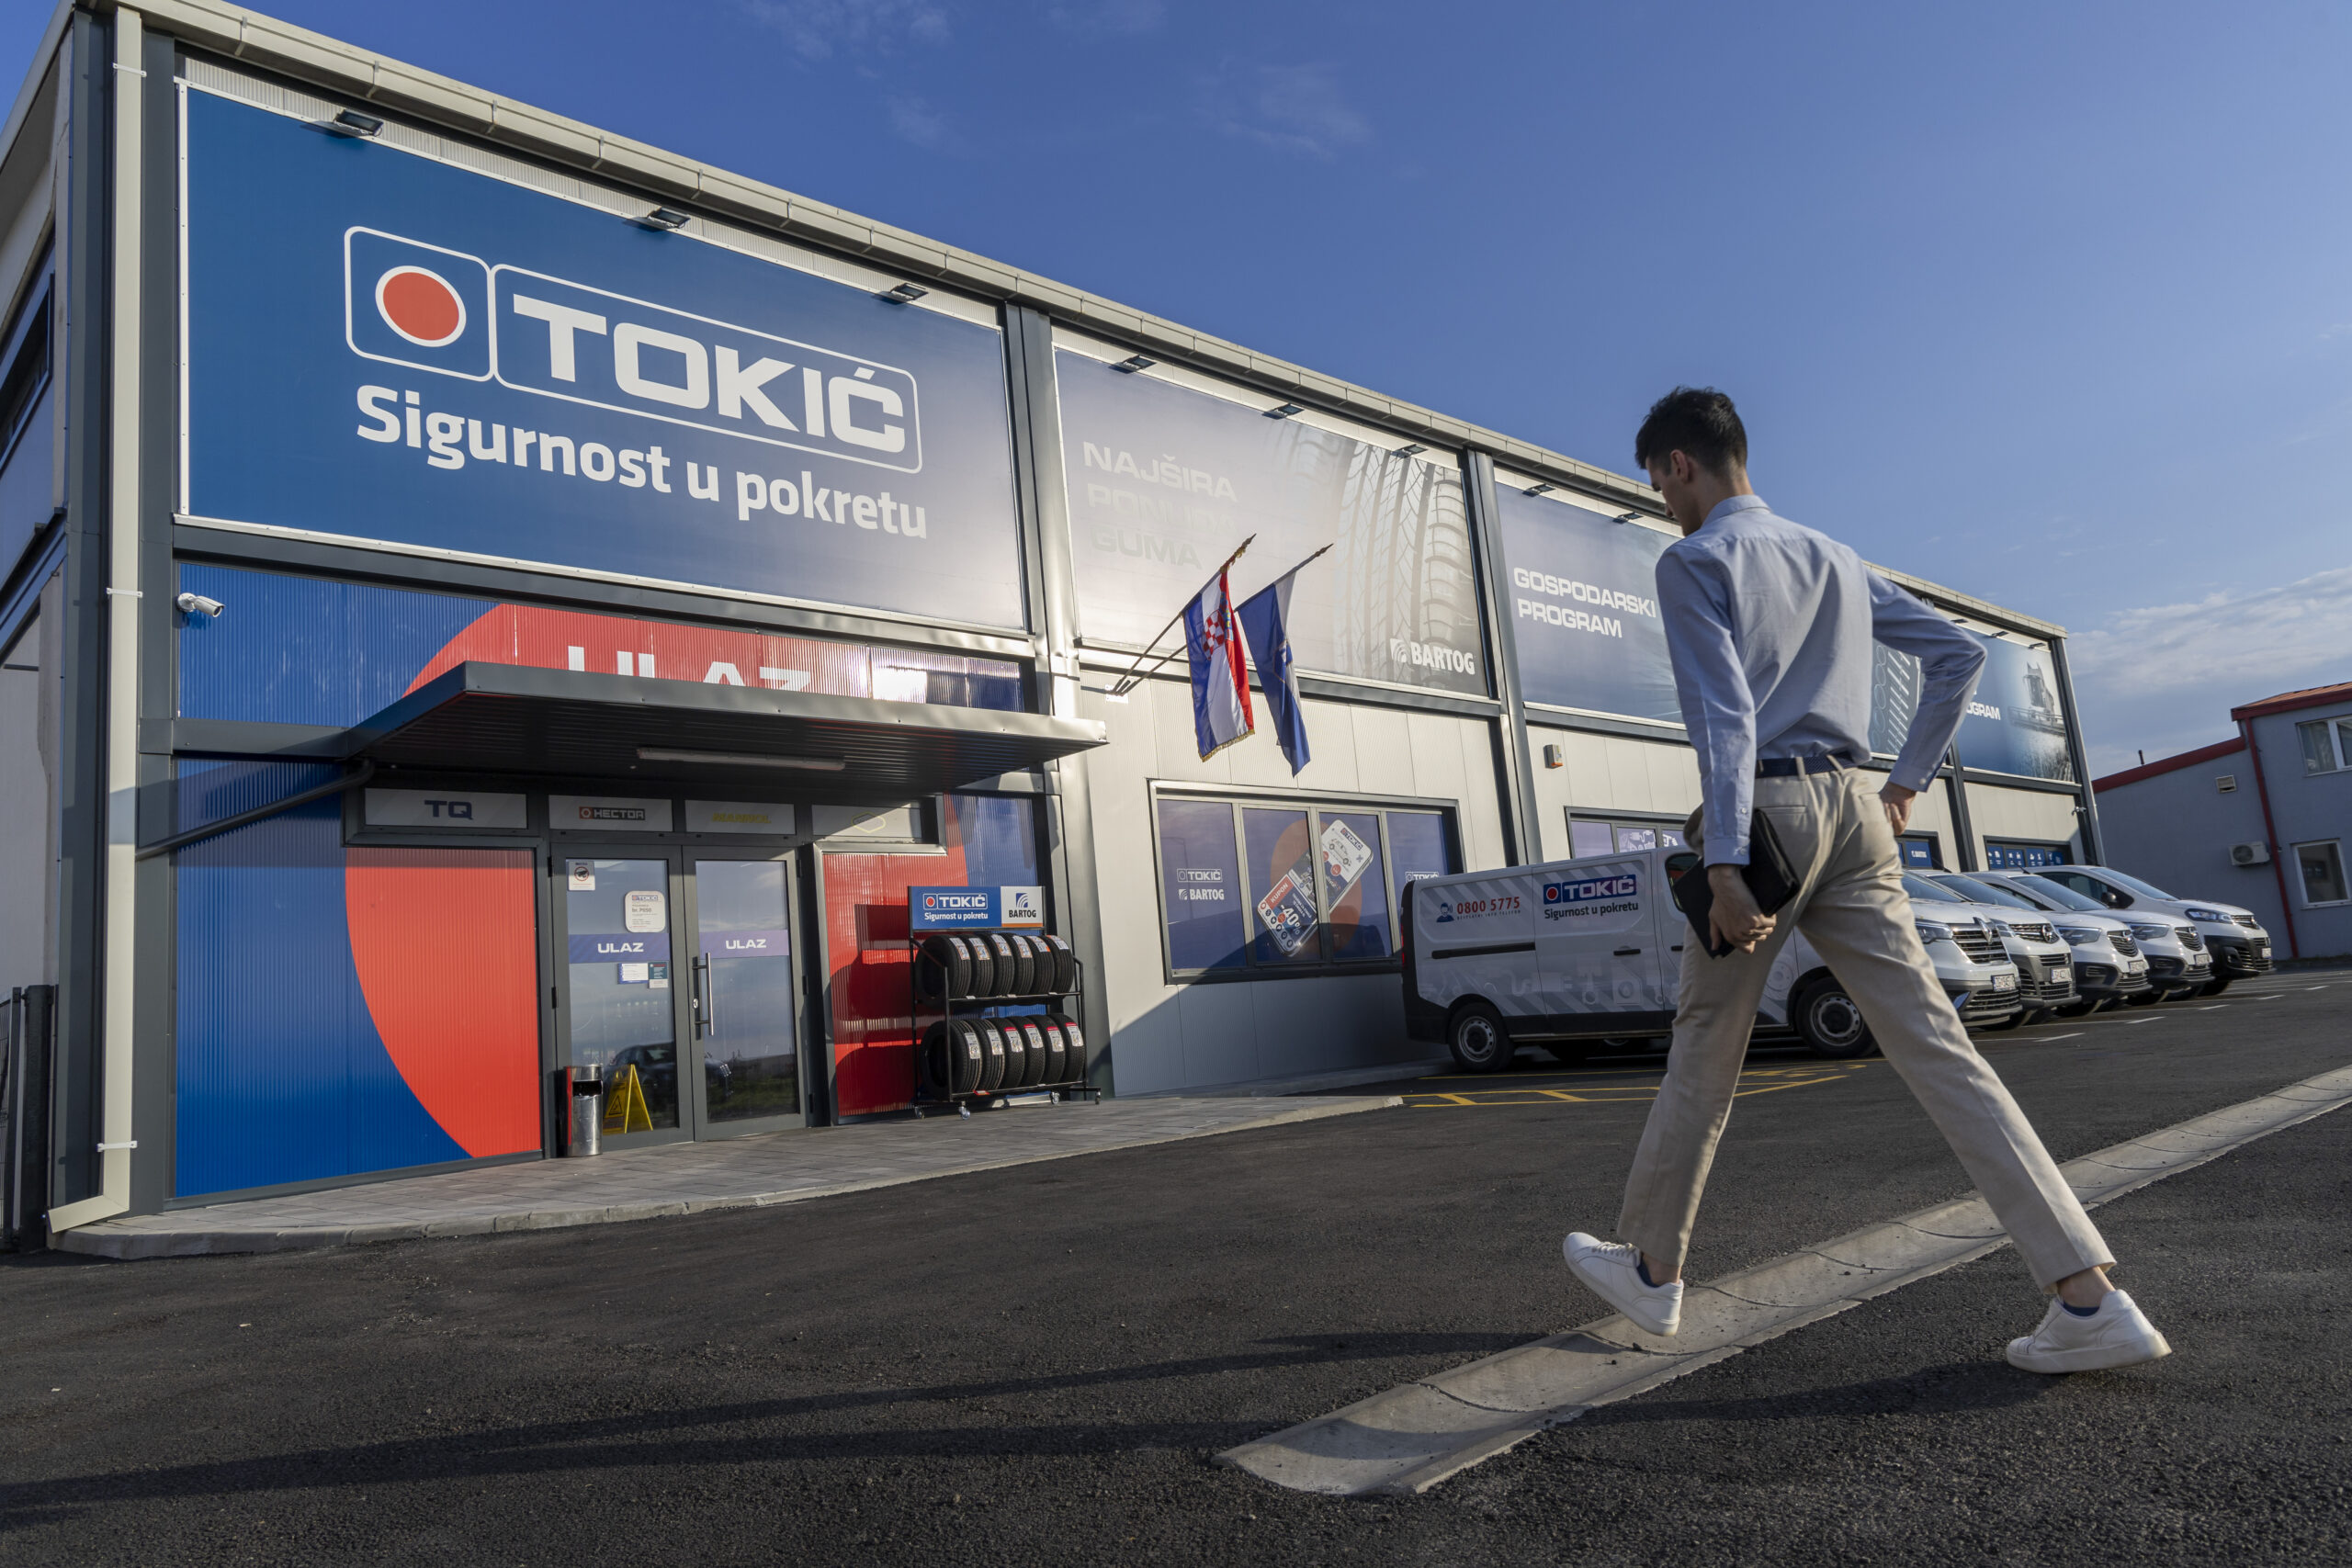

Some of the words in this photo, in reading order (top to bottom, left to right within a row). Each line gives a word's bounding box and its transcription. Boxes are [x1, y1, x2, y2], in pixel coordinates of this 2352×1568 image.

[514, 293, 905, 453] TOKIĆ
[356, 385, 672, 492] Sigurnost
[687, 461, 720, 502] u
[737, 470, 927, 539] pokretu
[1083, 441, 1238, 502] NAJŠIRA
[1087, 483, 1238, 536] PONUDA
[1090, 525, 1204, 570] GUMA
[1513, 567, 1657, 618] GOSPODARSKI
[1517, 598, 1623, 637] PROGRAM
[1410, 641, 1476, 675] BARTOG
[424, 799, 474, 820] TQ
[594, 808, 644, 819] HECTOR
[1188, 869, 1221, 880] TOKIĆ
[1190, 888, 1225, 900] BARTOG
[1271, 882, 1289, 904] KUPON
[1564, 875, 1634, 900] TOKIĆ
[939, 894, 986, 908] TOKIĆ
[1456, 900, 1486, 915] 0800
[1490, 897, 1521, 911] 5775
[1544, 906, 1589, 920] Sigurnost
[1591, 907, 1598, 915] u
[1600, 901, 1639, 917] pokretu
[924, 912, 956, 922] Sigurnost
[963, 911, 988, 921] pokretu
[1009, 909, 1036, 918] BARTOG
[597, 942, 644, 953] ULAZ
[726, 939, 767, 950] ULAZ
